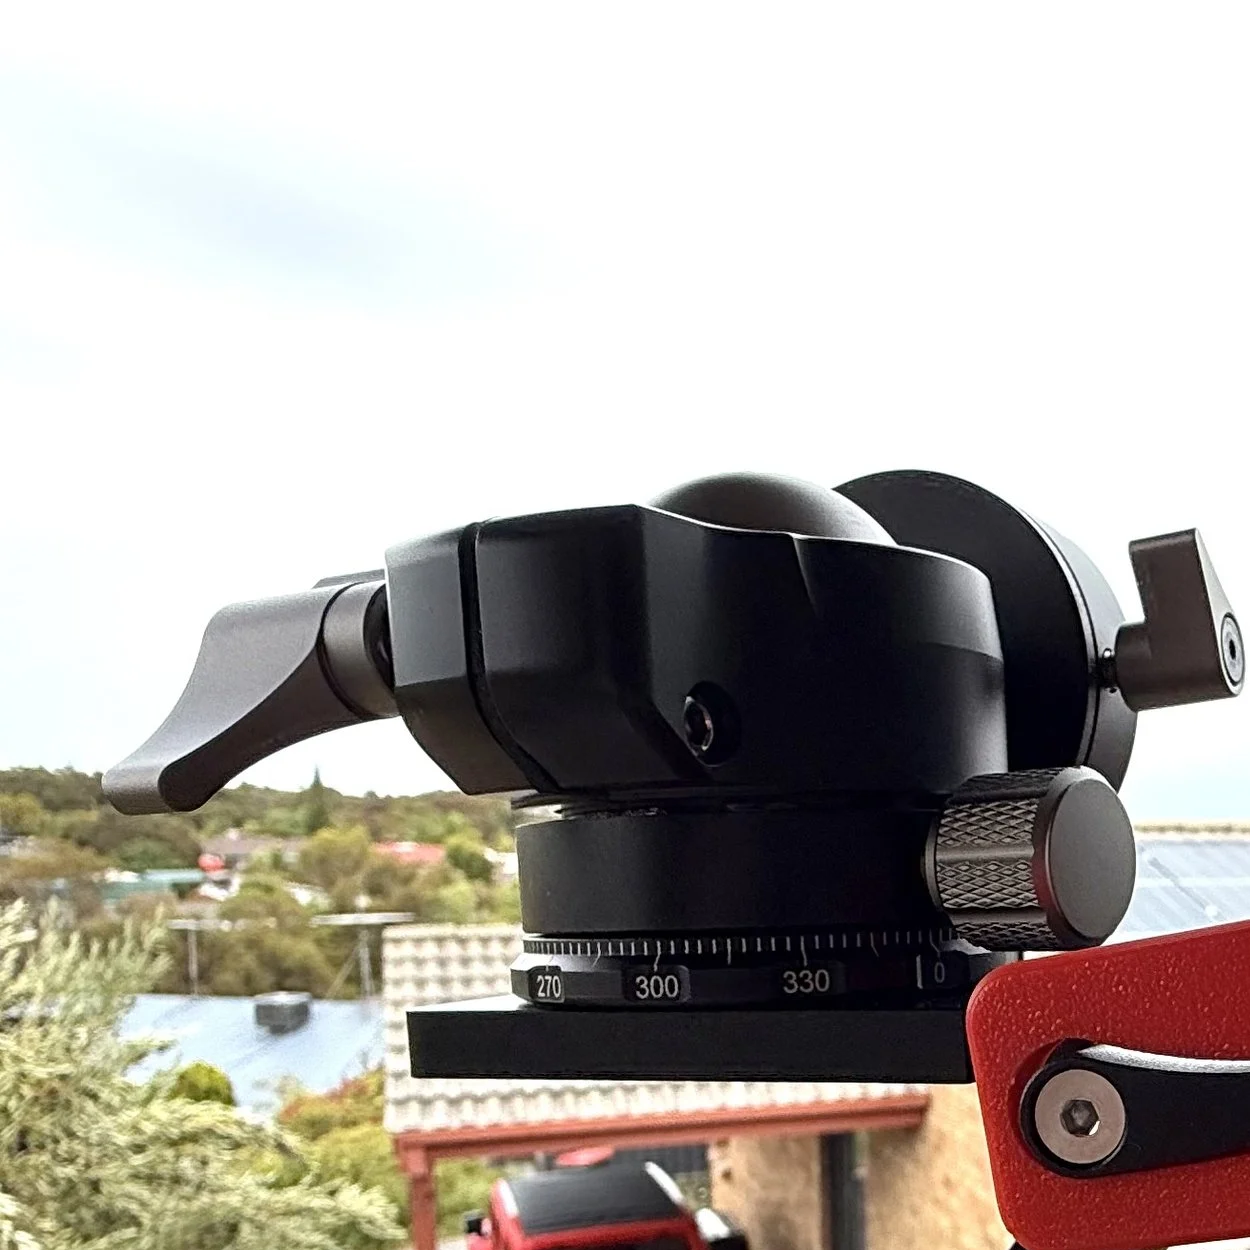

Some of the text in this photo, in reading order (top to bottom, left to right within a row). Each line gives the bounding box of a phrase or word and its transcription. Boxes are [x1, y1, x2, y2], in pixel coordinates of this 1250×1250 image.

[536, 975, 562, 998] 270
[635, 975, 679, 999] 300
[782, 969, 831, 993] 330
